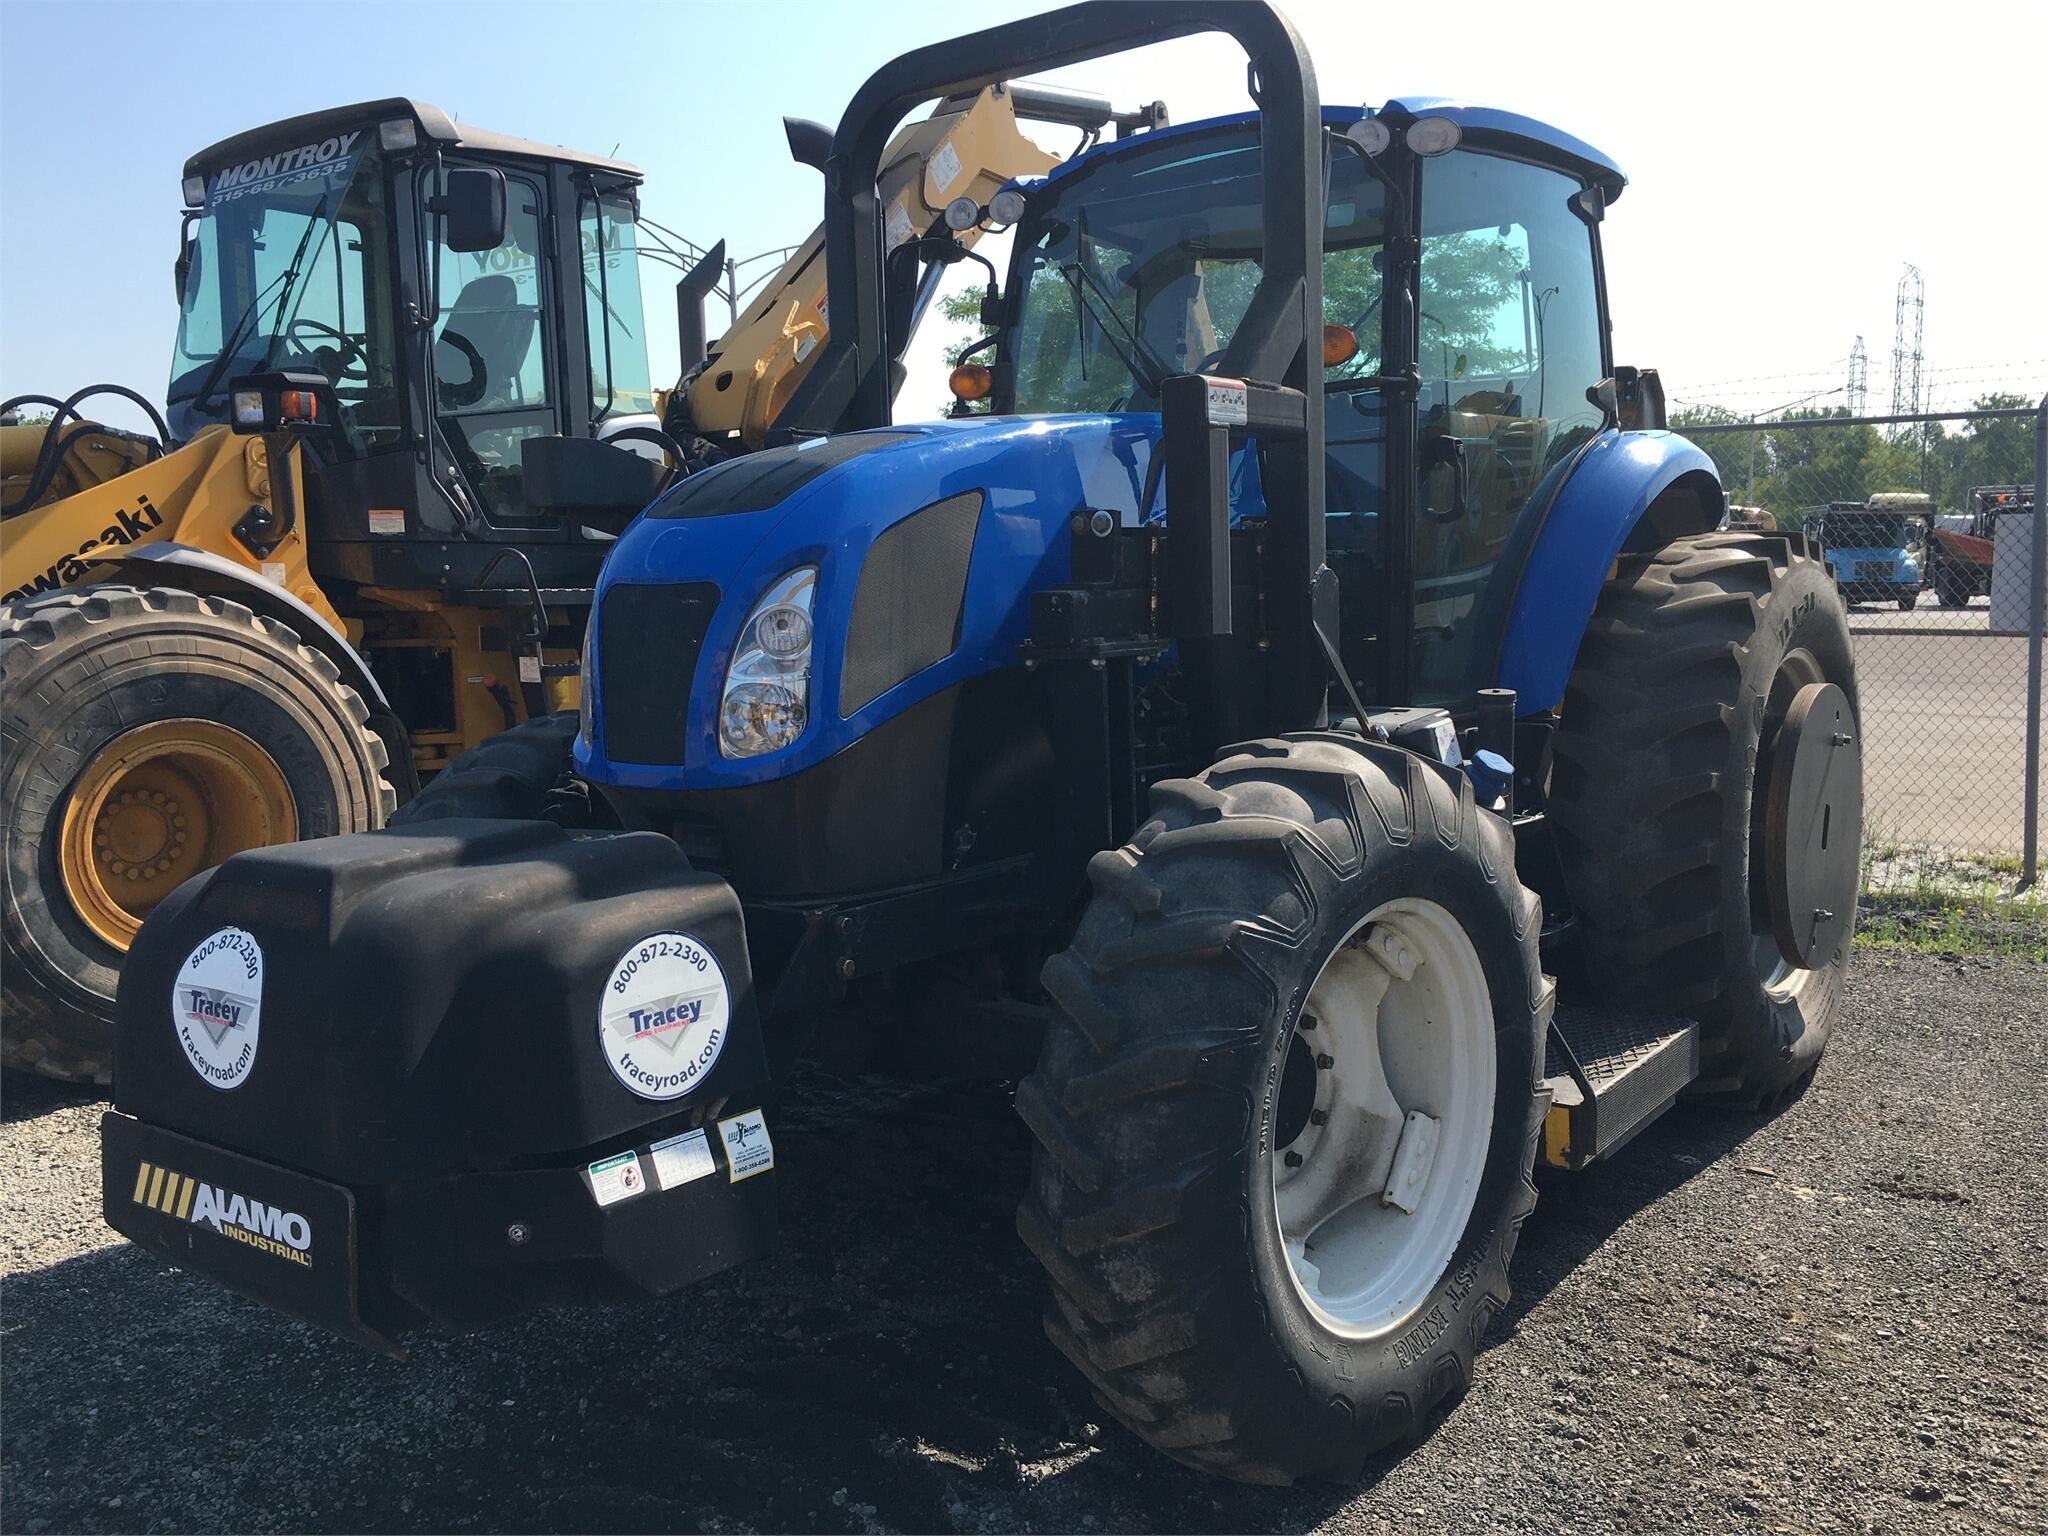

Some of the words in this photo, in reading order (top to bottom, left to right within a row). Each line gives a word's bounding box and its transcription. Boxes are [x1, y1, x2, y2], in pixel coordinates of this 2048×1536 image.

[216, 130, 361, 190] MONTROY
[191, 933, 259, 980] 800-872-2390
[613, 941, 708, 994] 800-872-2390
[190, 989, 241, 1028] Tracey
[628, 999, 702, 1034] Tracey
[181, 1025, 252, 1081] traceyroad.com
[620, 1028, 721, 1092] traceyroad.com
[597, 1156, 629, 1170] IMPORTANT
[191, 1182, 312, 1251] ALAMO
[223, 1224, 309, 1266] INDUSTRIAL
